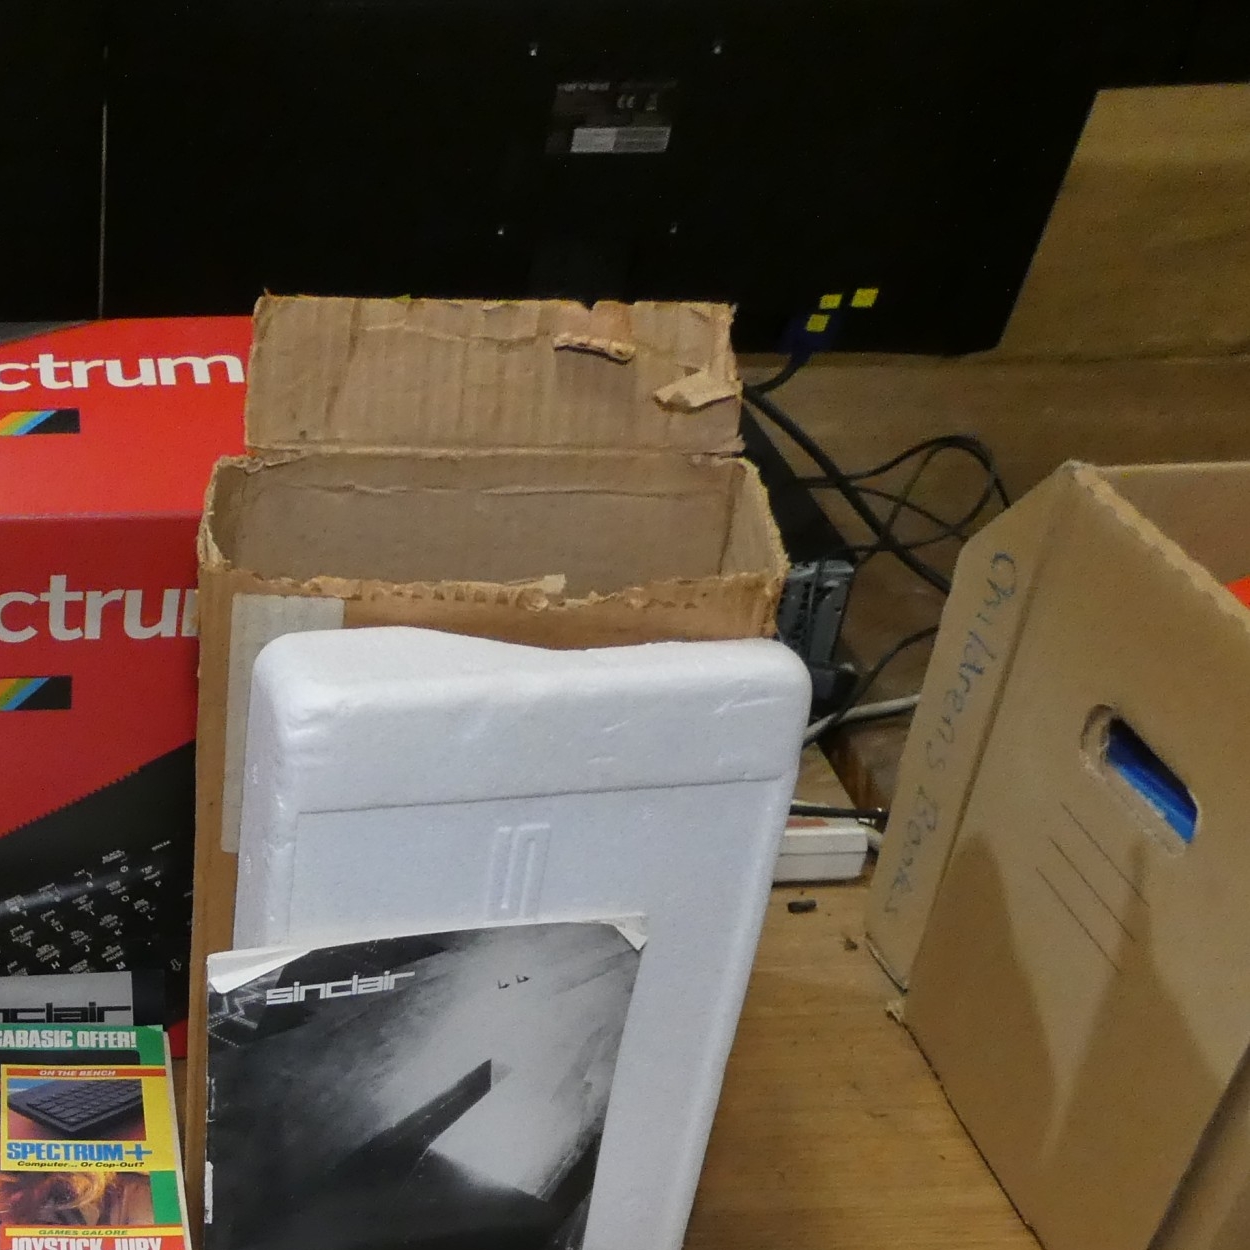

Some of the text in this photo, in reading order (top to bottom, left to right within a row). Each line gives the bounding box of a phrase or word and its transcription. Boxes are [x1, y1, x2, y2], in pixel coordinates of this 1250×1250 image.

[266, 970, 416, 1006] sinclair
[77, 1031, 136, 1048] OFFER!
[7, 1143, 152, 1161] SPECTRUM+
